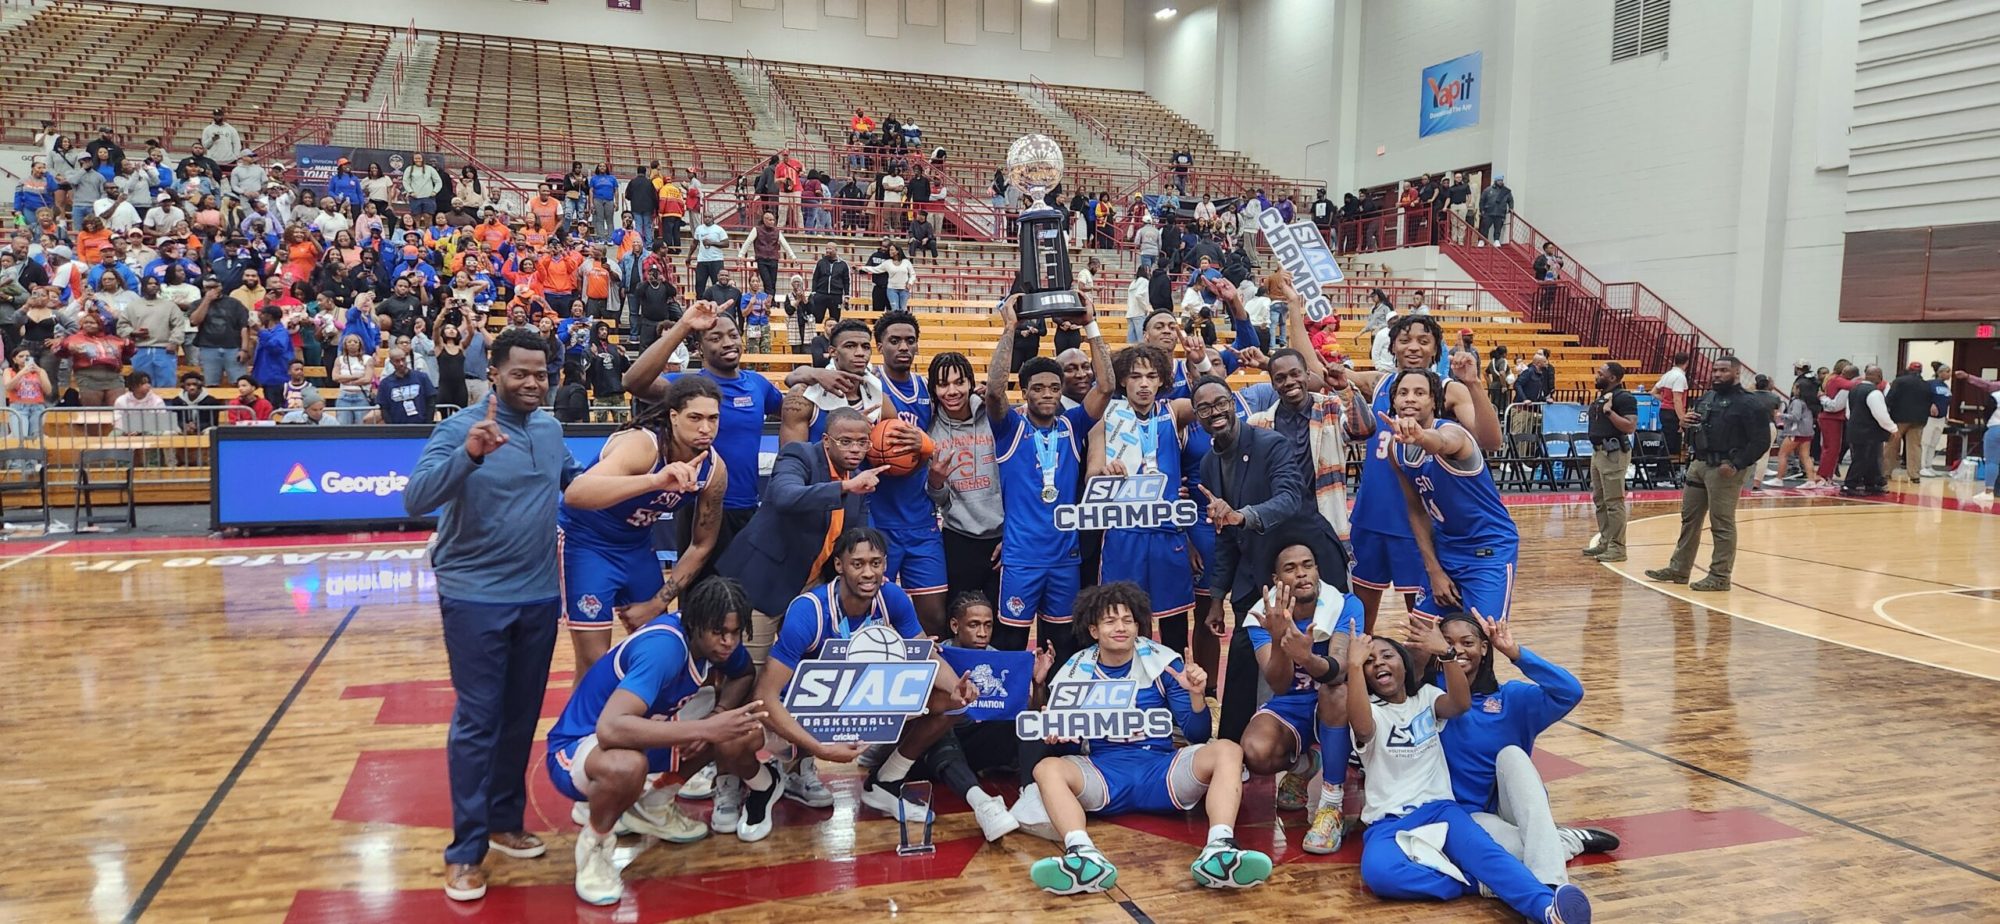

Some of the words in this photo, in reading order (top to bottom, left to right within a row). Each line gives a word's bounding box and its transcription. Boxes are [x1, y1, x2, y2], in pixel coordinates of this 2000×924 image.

[1428, 72, 1474, 108] Yapit
[1259, 208, 1331, 321] CHAMPS
[1293, 226, 1338, 278] SIAC
[321, 470, 409, 496] Georgia
[1089, 478, 1162, 500] SIAC
[1055, 502, 1197, 529] CHAMPS
[792, 669, 929, 707] SIAC
[1054, 685, 1132, 706] SIAC
[978, 700, 1005, 709] NATION
[803, 717, 894, 726] BASKETBALL
[1017, 711, 1171, 738] CHAMPS
